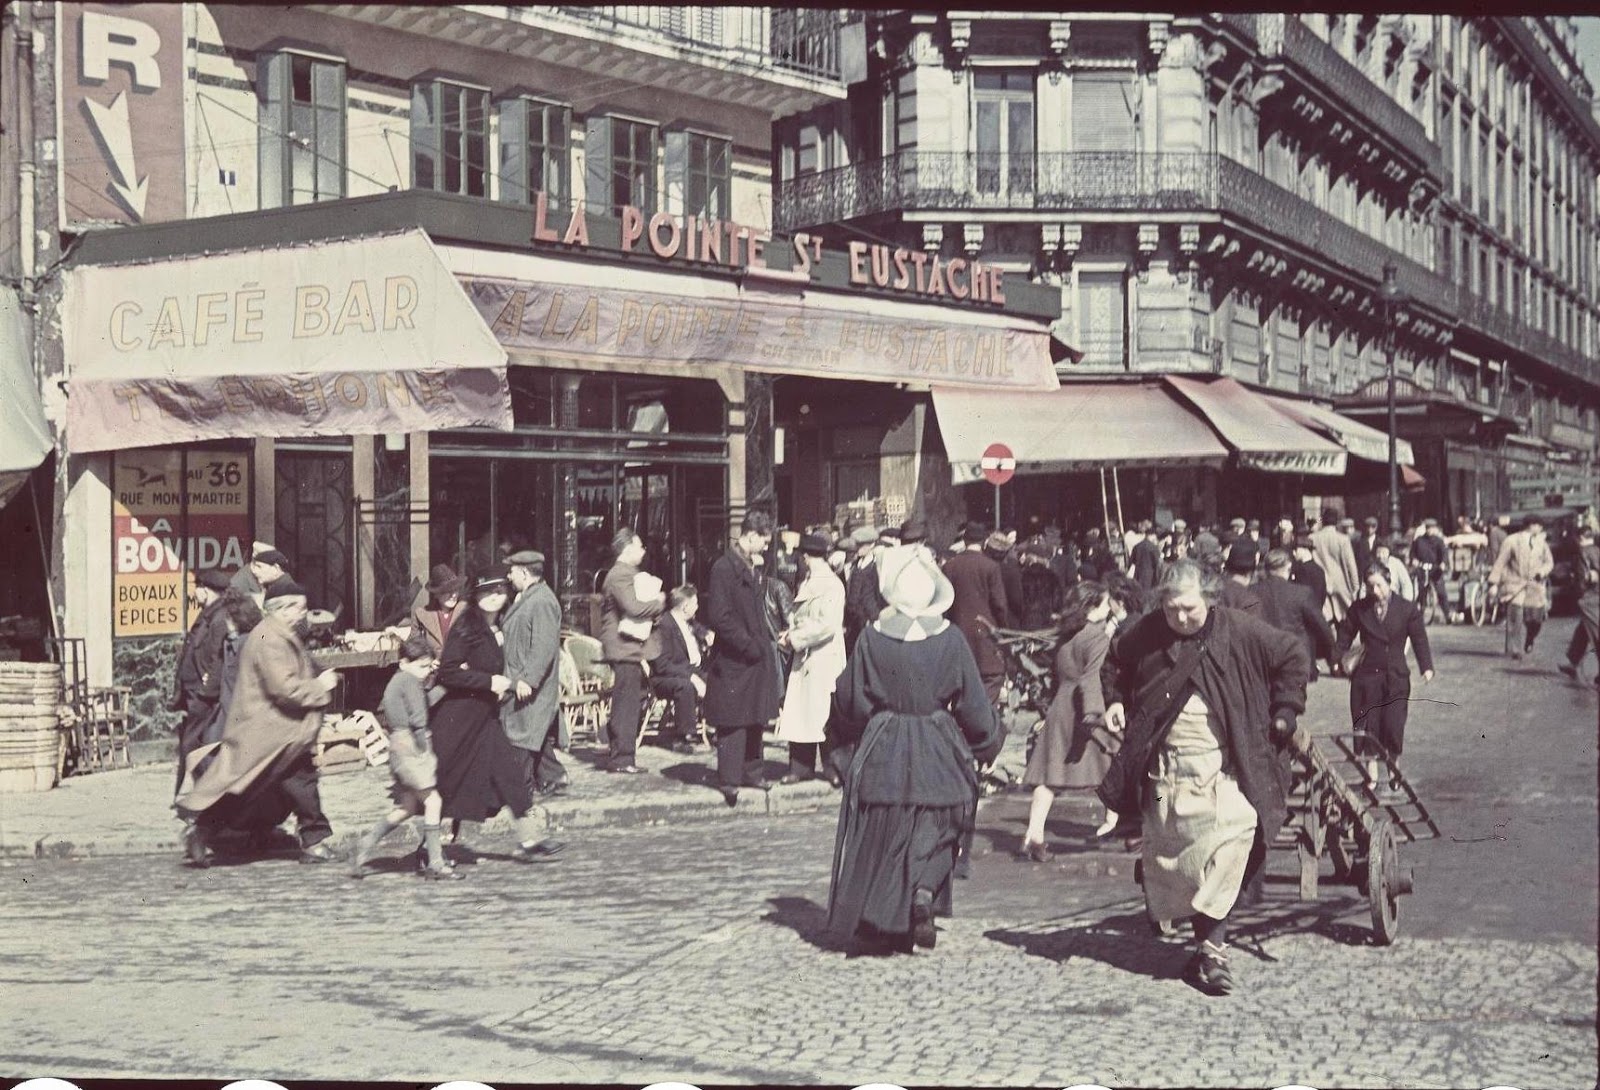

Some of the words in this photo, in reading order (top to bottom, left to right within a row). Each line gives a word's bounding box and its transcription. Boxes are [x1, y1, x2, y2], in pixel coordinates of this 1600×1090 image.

[82, 11, 162, 89] R
[534, 191, 590, 247] LA
[622, 204, 767, 269] POINTE
[849, 240, 1006, 305] EUSTACHE
[109, 281, 266, 353] CAFÉ
[292, 275, 420, 340] BAR
[490, 289, 527, 339] A
[540, 292, 599, 346] LA
[615, 298, 766, 348] POINTE
[838, 318, 1017, 378] EUSTACHE
[187, 470, 203, 480] AU
[209, 462, 241, 487] 36
[121, 493, 143, 505] RUE
[131, 518, 172, 534] LA
[118, 536, 245, 573] BOVIDA
[119, 584, 178, 602] BOYAUX
[120, 607, 178, 626] ÉPICES
